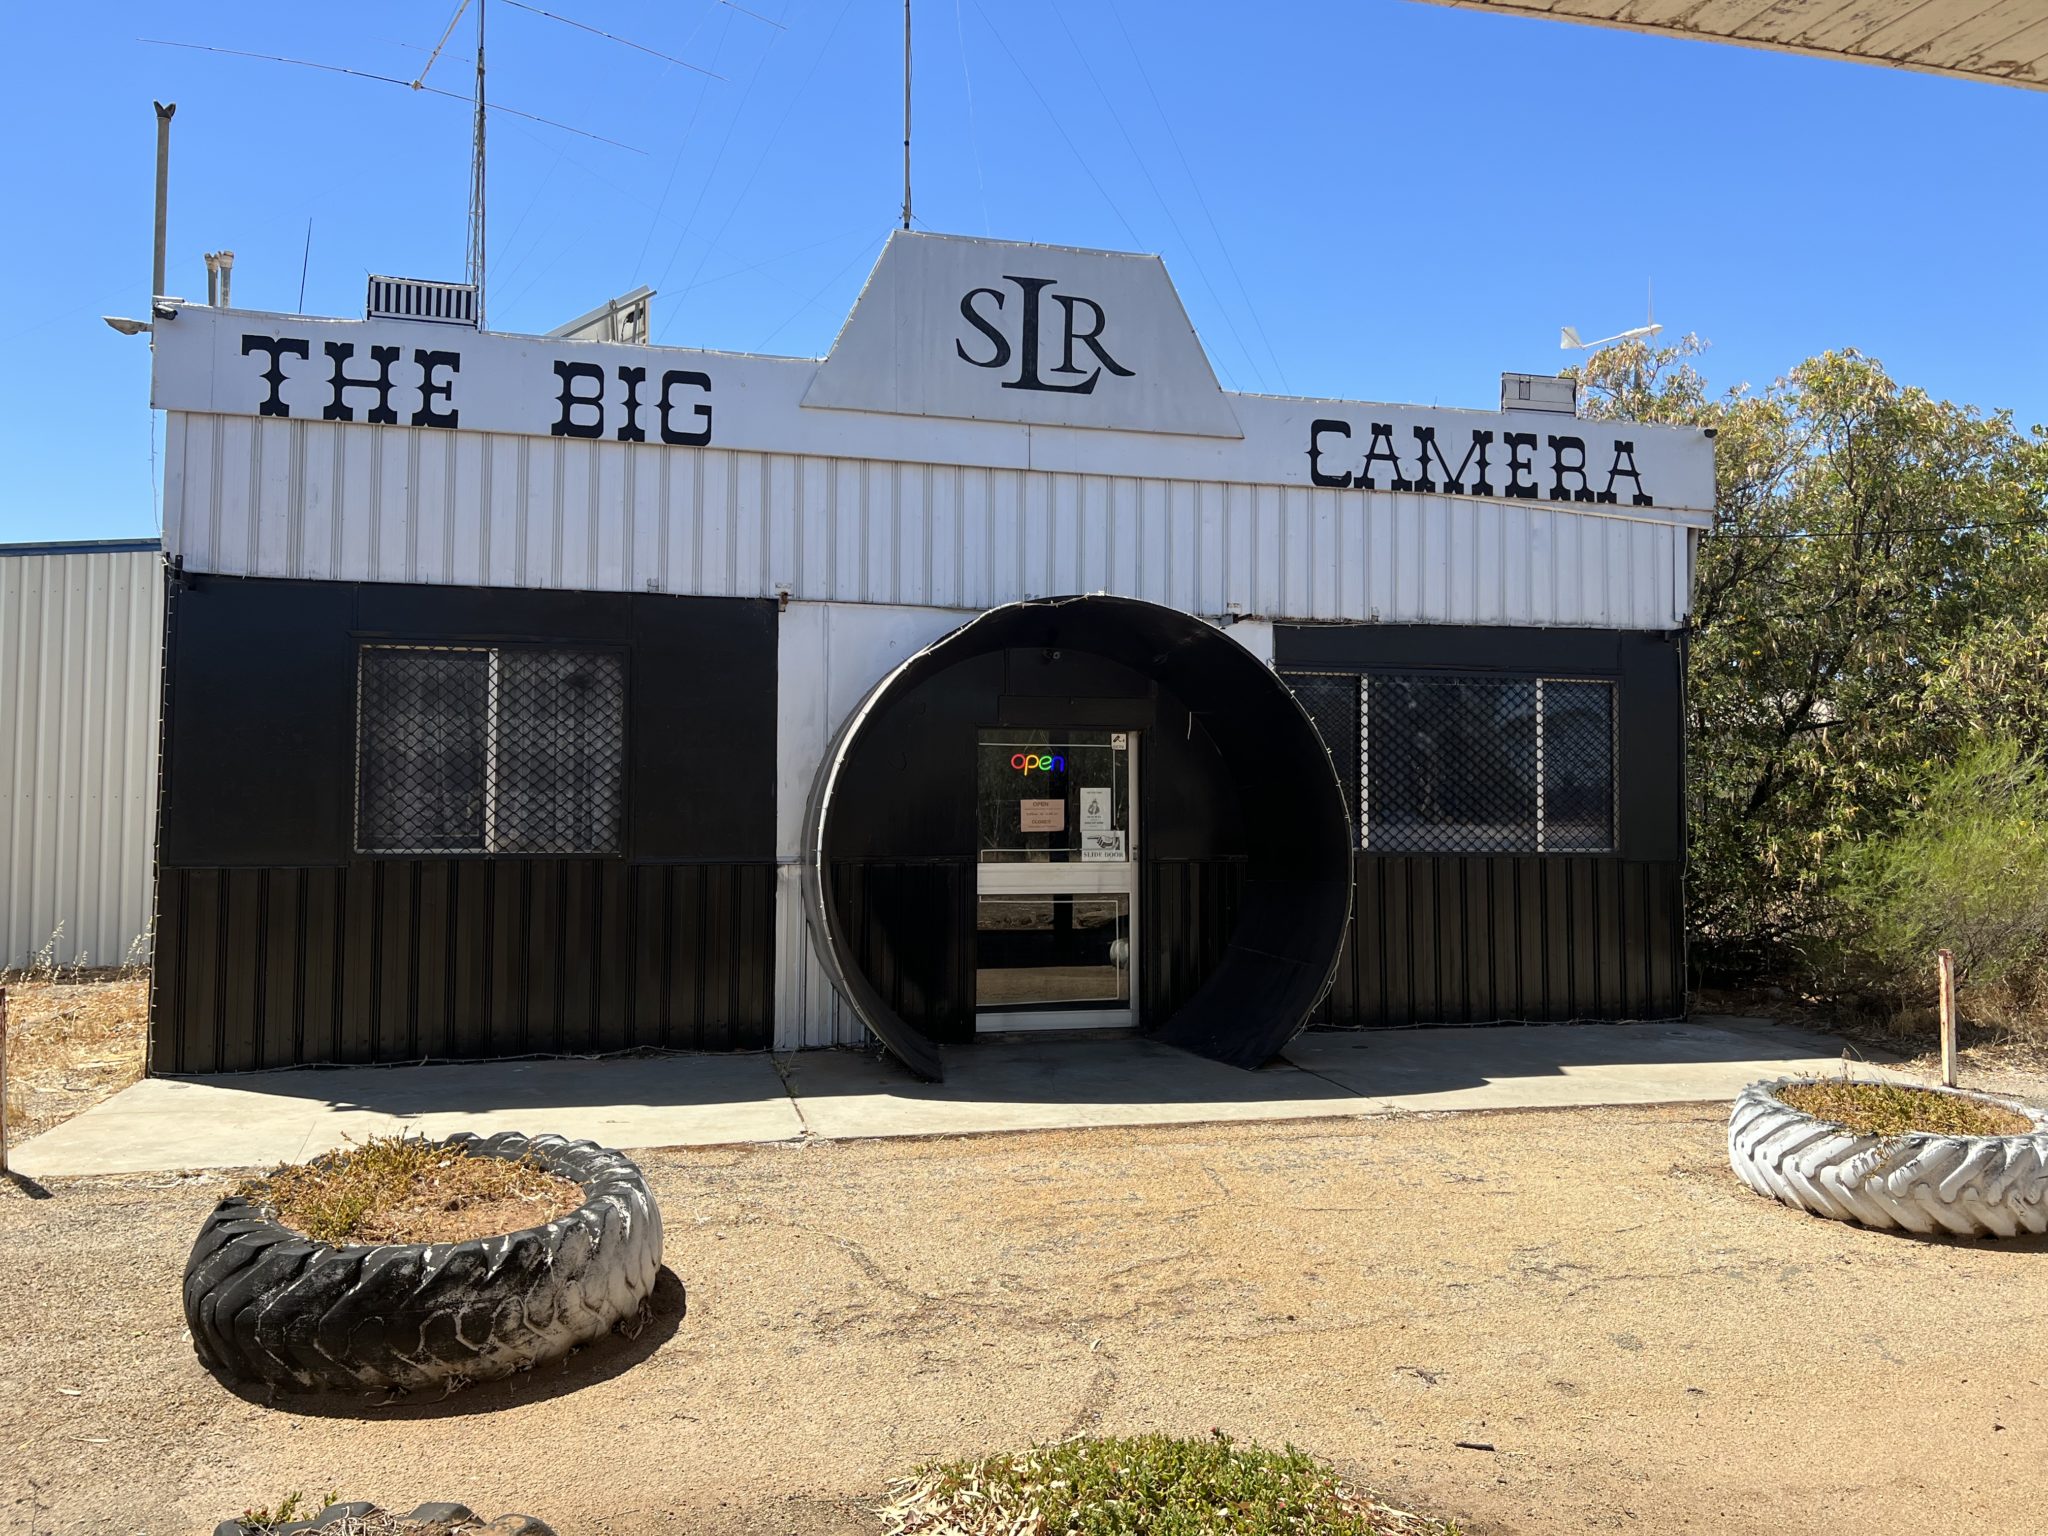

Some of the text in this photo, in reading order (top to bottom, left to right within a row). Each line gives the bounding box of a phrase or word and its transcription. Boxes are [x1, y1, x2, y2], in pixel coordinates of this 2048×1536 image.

[956, 275, 1136, 395] SLR
[241, 333, 1654, 507] THE BIG CAMERA
[1010, 753, 1066, 776] open
